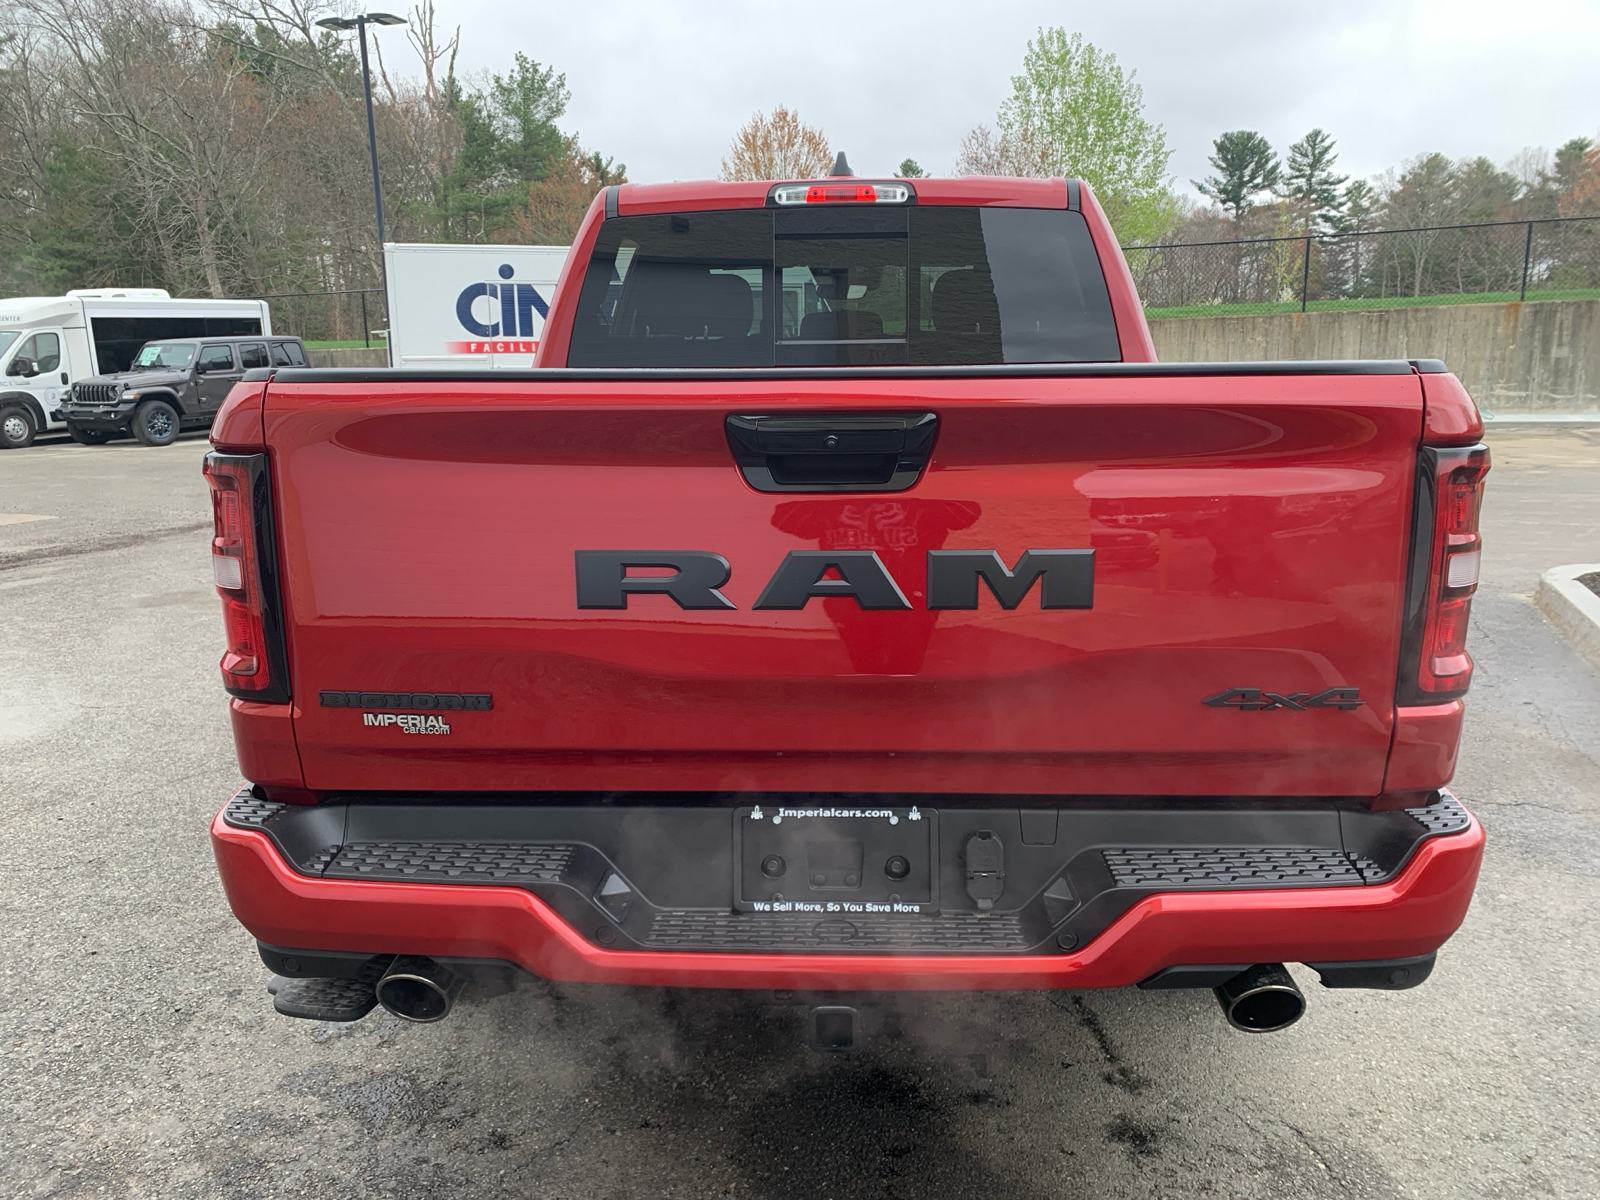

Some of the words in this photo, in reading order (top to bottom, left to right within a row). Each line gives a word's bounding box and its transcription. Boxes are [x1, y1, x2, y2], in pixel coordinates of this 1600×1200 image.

[574, 549, 1097, 610] RAM
[318, 690, 492, 711] BIGHORN
[1201, 686, 1367, 711] 4x4
[363, 713, 450, 728] IMPERIAL
[403, 725, 451, 735] cars.com
[779, 808, 893, 818] Imperialcars.com
[753, 902, 767, 911] We
[773, 902, 792, 912] Sell
[795, 902, 824, 913] More,
[827, 903, 840, 912] So
[843, 903, 863, 912] You
[865, 903, 891, 912] Save
[893, 903, 920, 913] More
